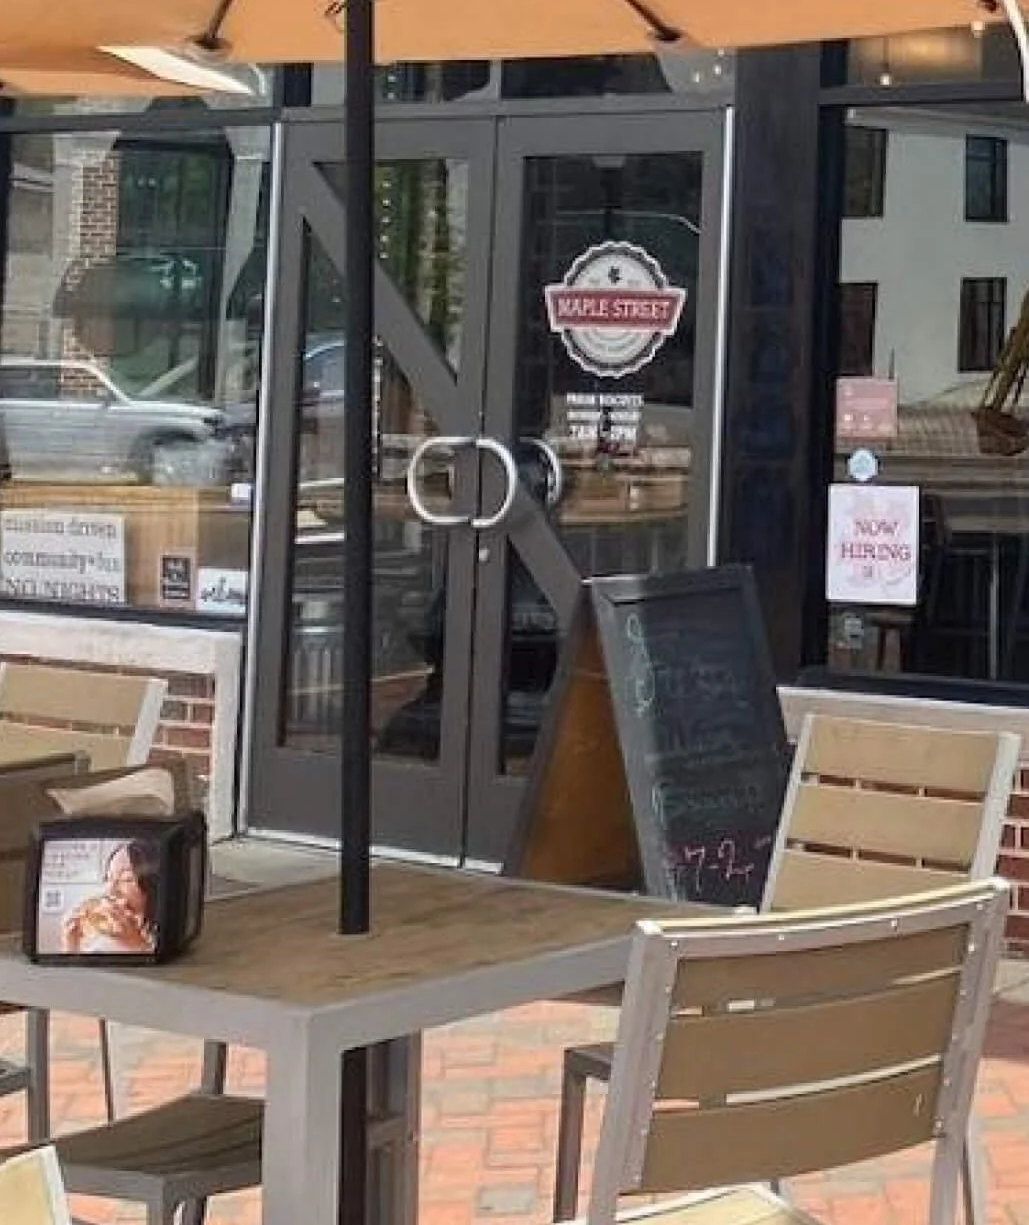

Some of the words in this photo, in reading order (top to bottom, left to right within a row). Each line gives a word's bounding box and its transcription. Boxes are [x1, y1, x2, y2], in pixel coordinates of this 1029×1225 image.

[557, 298, 609, 318] MAPLE
[613, 299, 670, 320] STREET
[855, 518, 899, 537] NOW
[840, 541, 912, 562] HIRING
